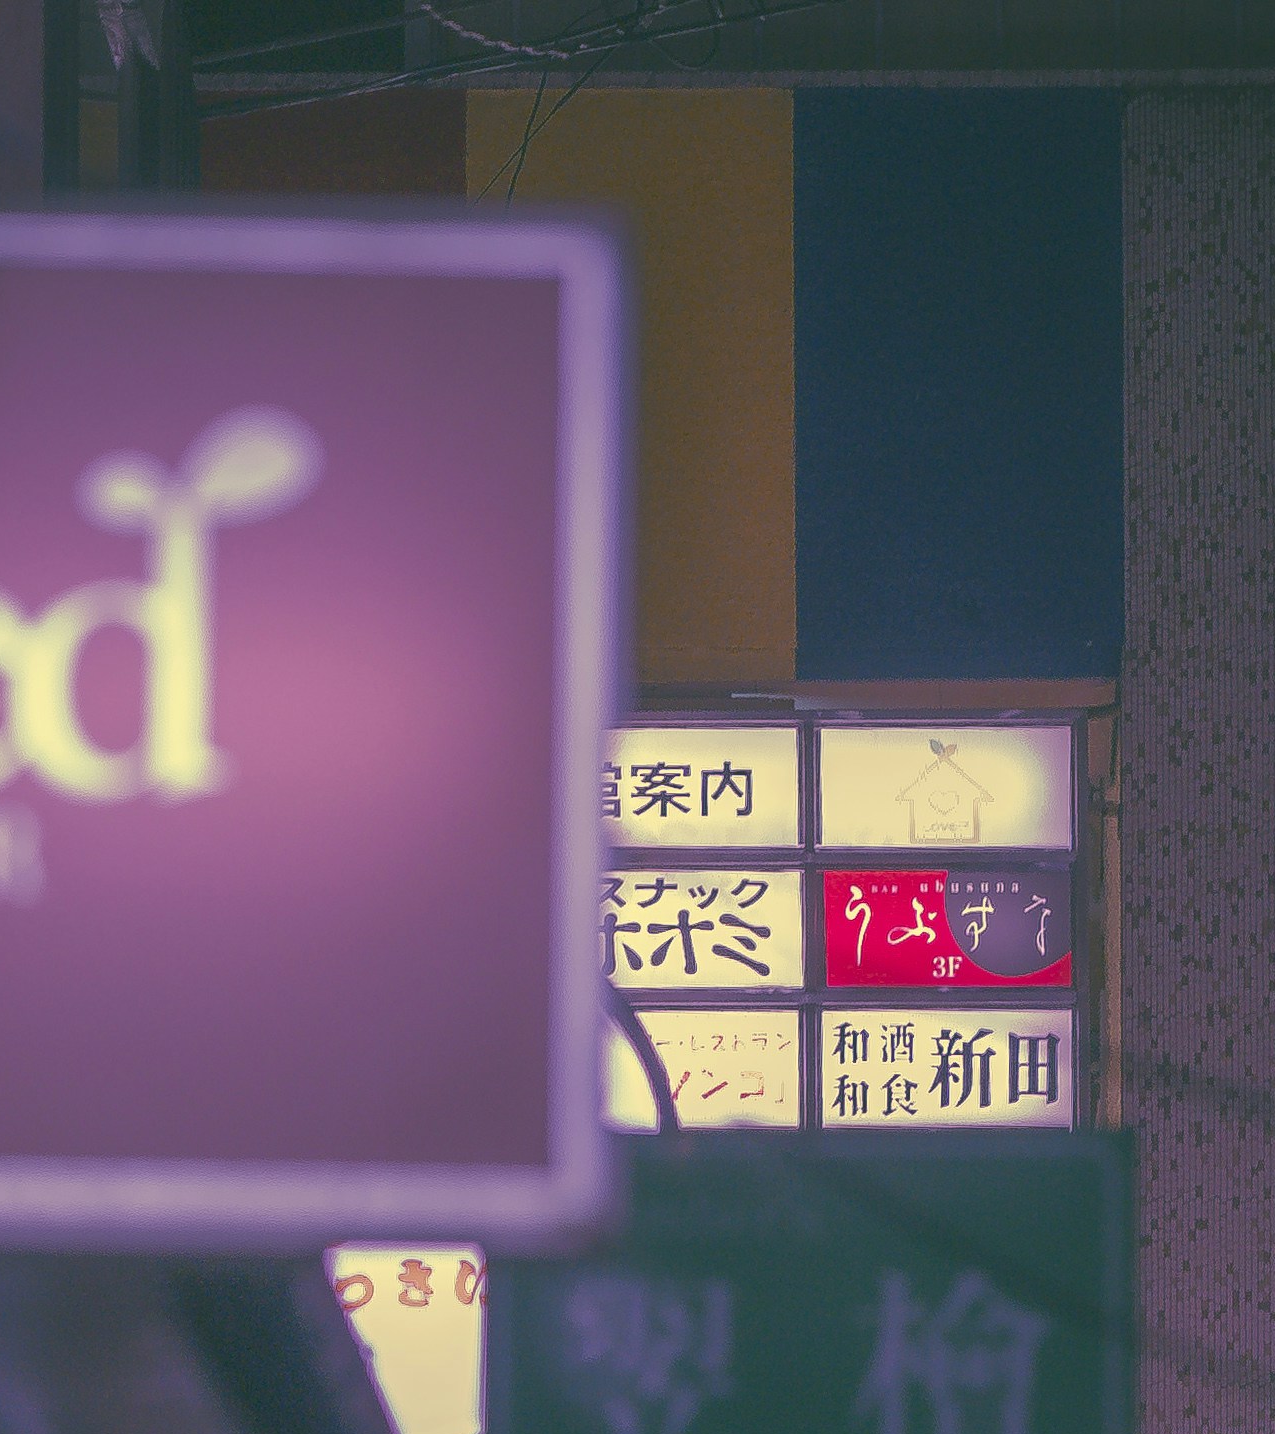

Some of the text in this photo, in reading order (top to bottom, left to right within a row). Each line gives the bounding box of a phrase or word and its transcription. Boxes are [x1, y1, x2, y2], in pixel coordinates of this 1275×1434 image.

[600, 877, 770, 910] スナック
[871, 884, 899, 894] BAR
[932, 955, 964, 979] 3F
[648, 1031, 792, 1052] ー・レストラン
[831, 1022, 916, 1065] 和酒
[928, 1027, 1061, 1109] 新田
[831, 1073, 919, 1117] 和食
